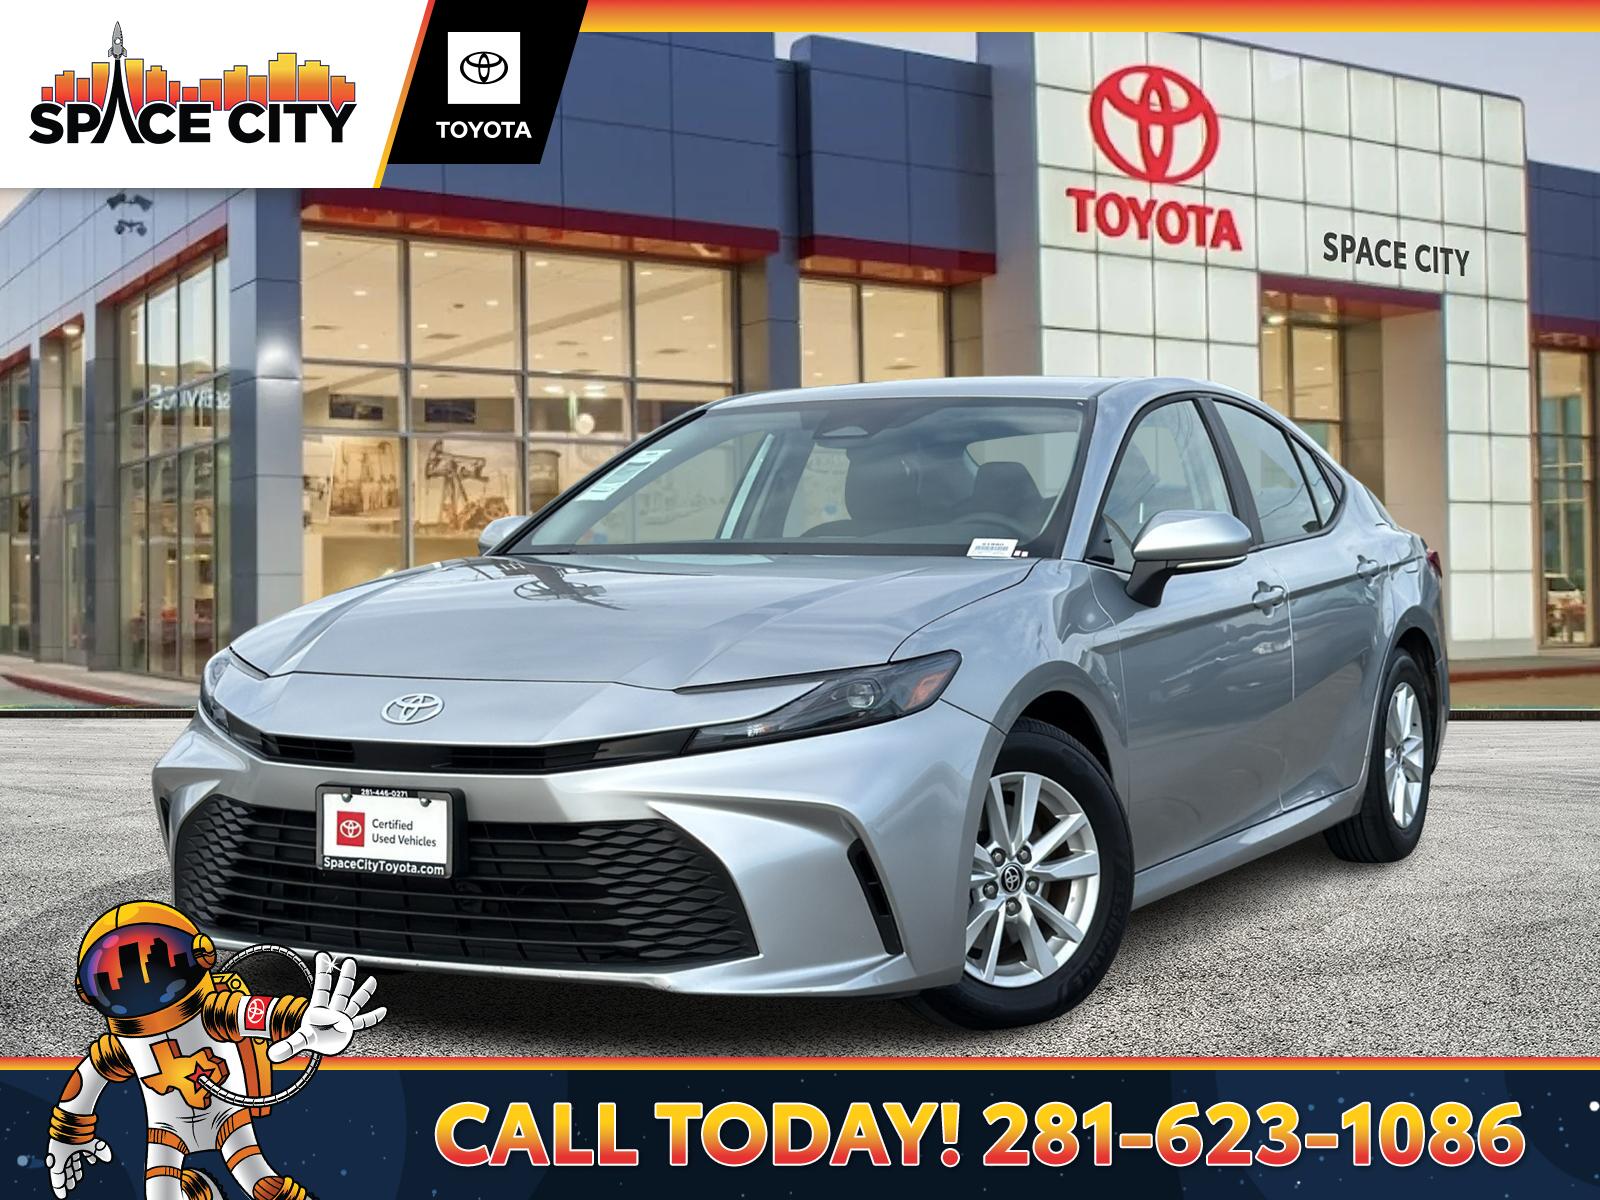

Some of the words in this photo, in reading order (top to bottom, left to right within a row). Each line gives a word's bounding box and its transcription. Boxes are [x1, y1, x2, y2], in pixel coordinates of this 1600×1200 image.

[1066, 187, 1243, 251] TOYOTA
[1323, 231, 1407, 270] SPACE
[1414, 243, 1470, 277] CITY
[372, 818, 413, 831] Certified
[372, 833, 396, 844] Used
[398, 835, 437, 847] Vehicles
[323, 857, 445, 876] SpaceCityToyota.com
